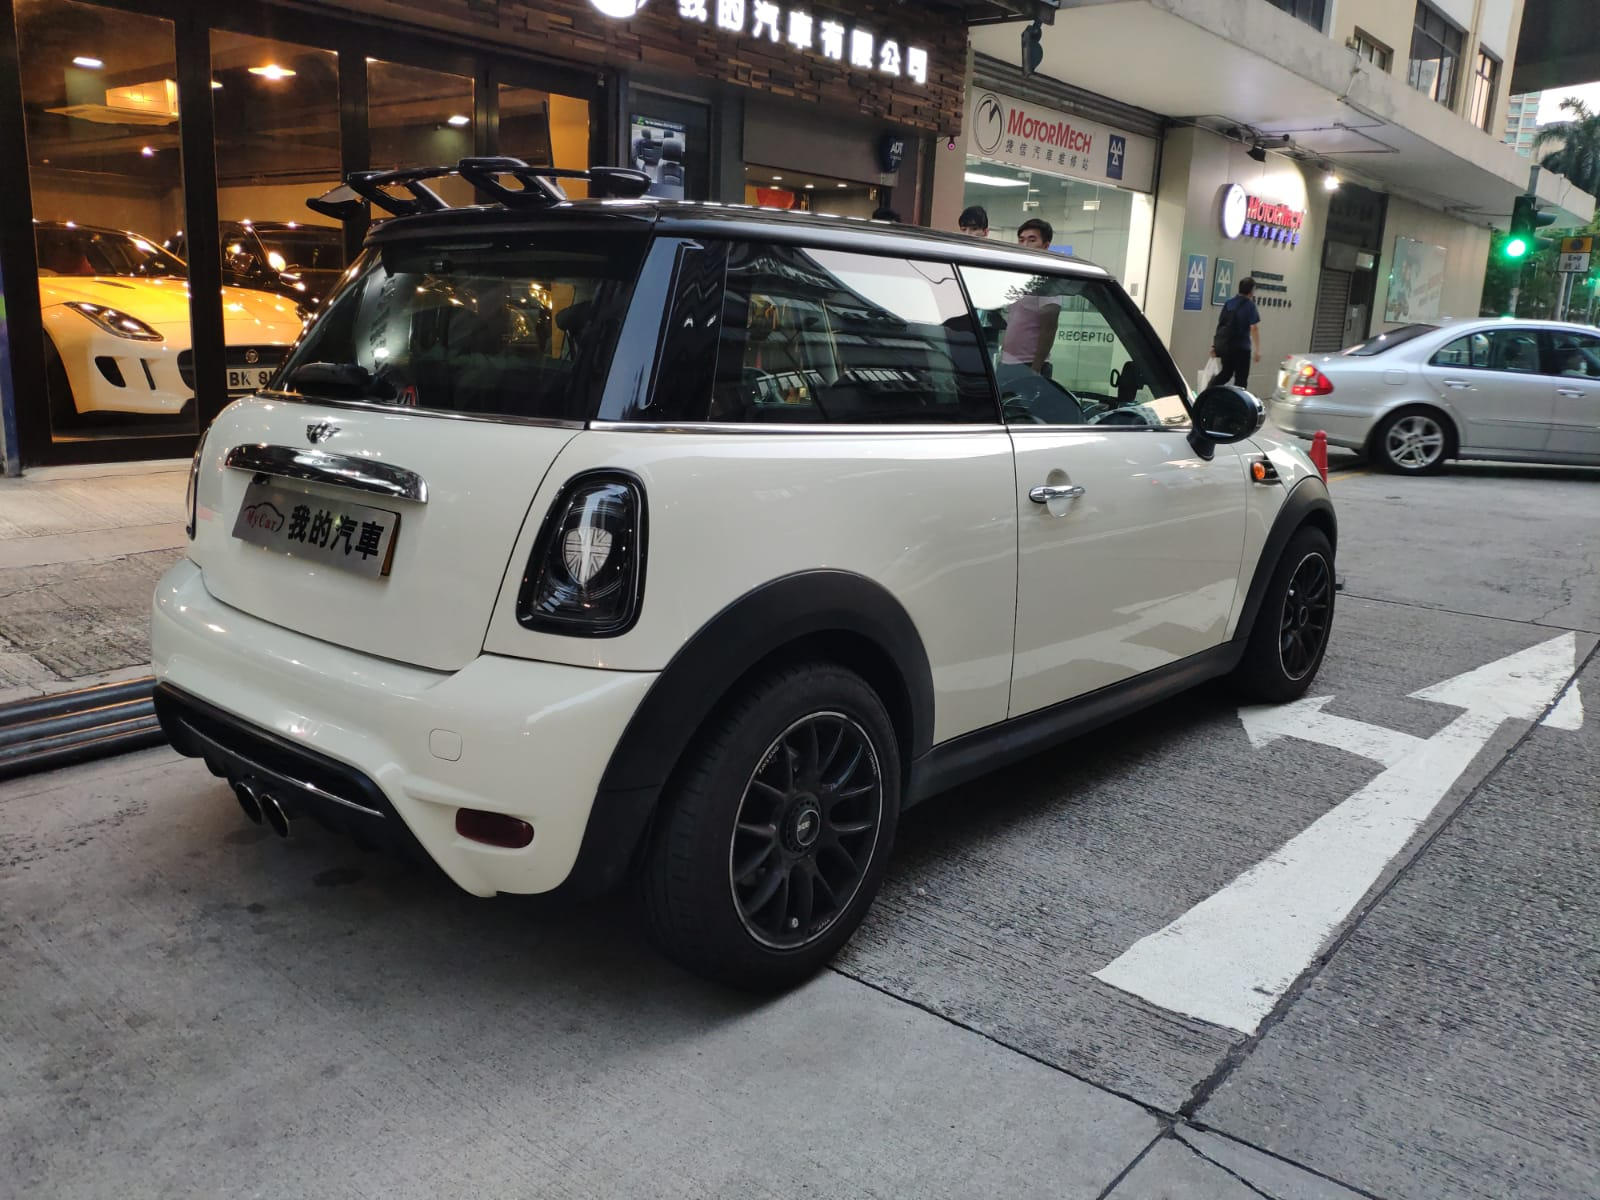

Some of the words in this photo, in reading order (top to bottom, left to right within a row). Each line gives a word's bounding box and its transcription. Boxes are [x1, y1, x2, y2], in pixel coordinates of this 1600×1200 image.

[1058, 330, 1115, 343] RECEPTIO
[229, 371, 251, 387] BK
[288, 504, 384, 560] 我的汽車
